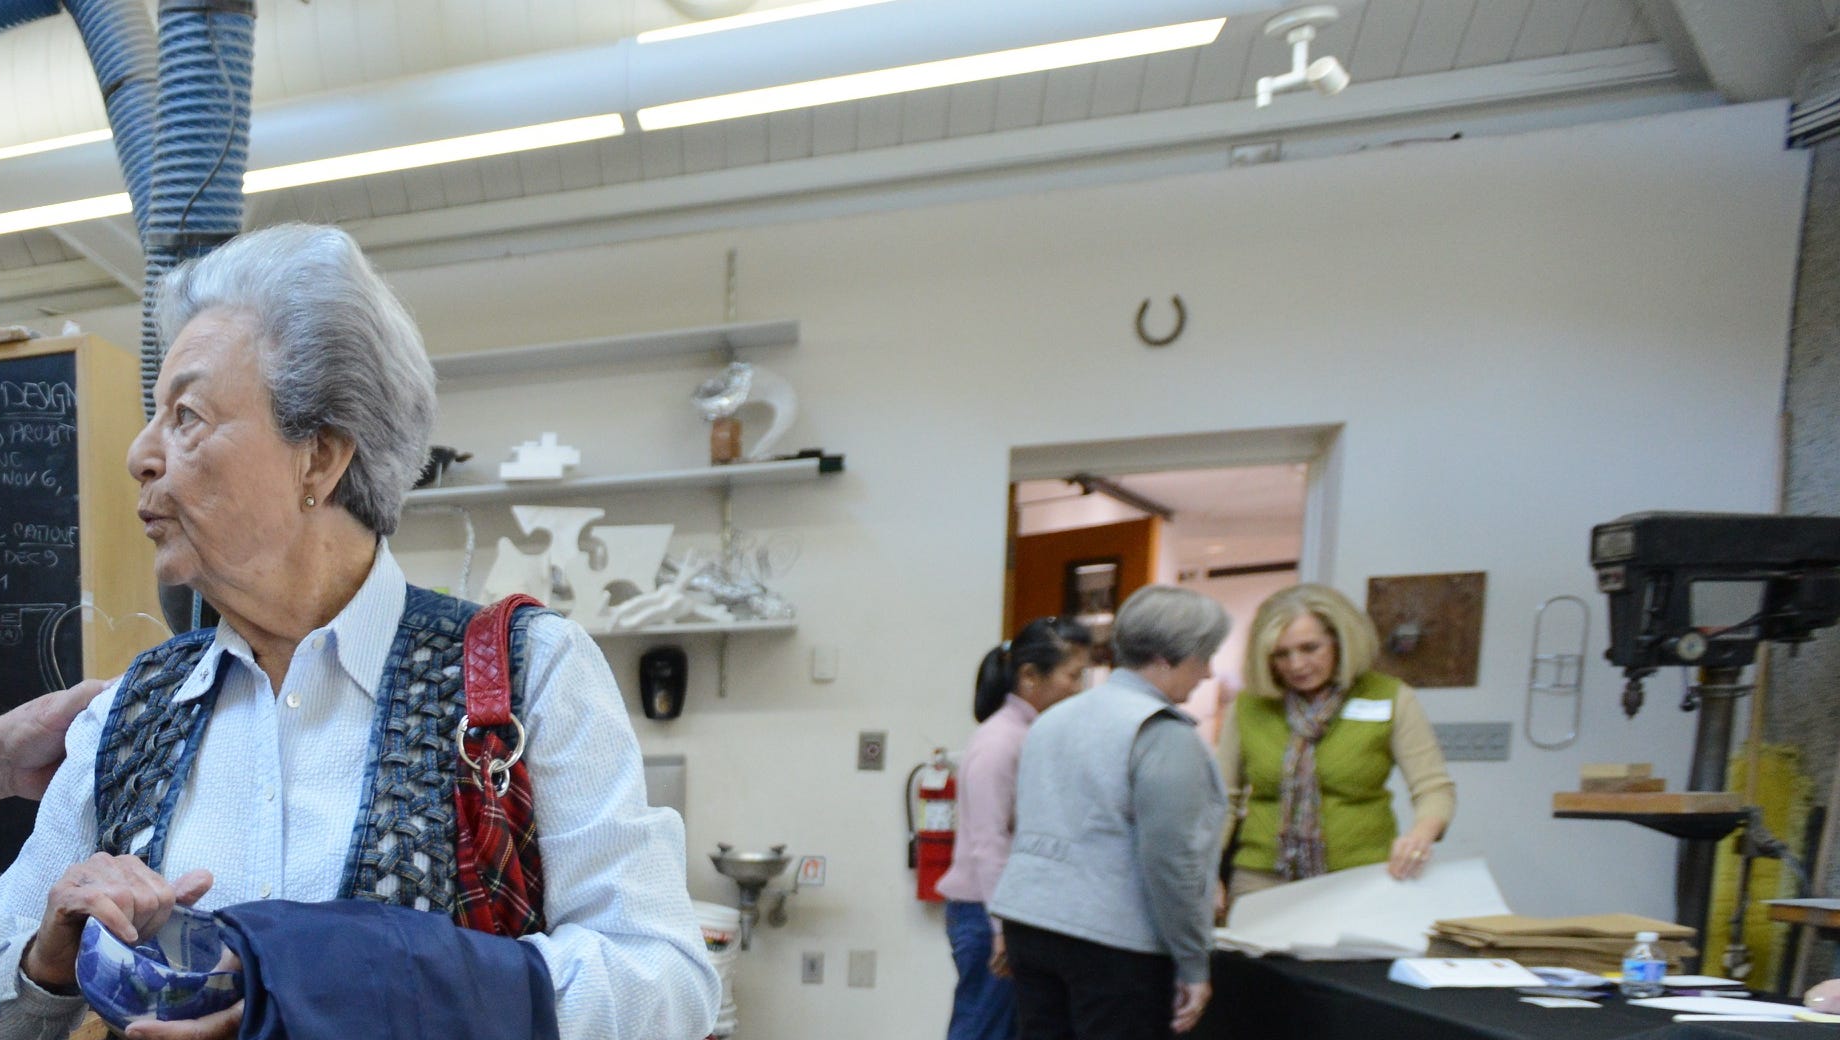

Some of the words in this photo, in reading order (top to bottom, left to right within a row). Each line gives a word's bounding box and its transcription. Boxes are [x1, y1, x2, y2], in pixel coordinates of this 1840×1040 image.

[1, 381, 78, 415] DESIGN
[2, 470, 38, 486] NOV
[4, 549, 41, 565] DEC
[44, 549, 58, 568] 9
